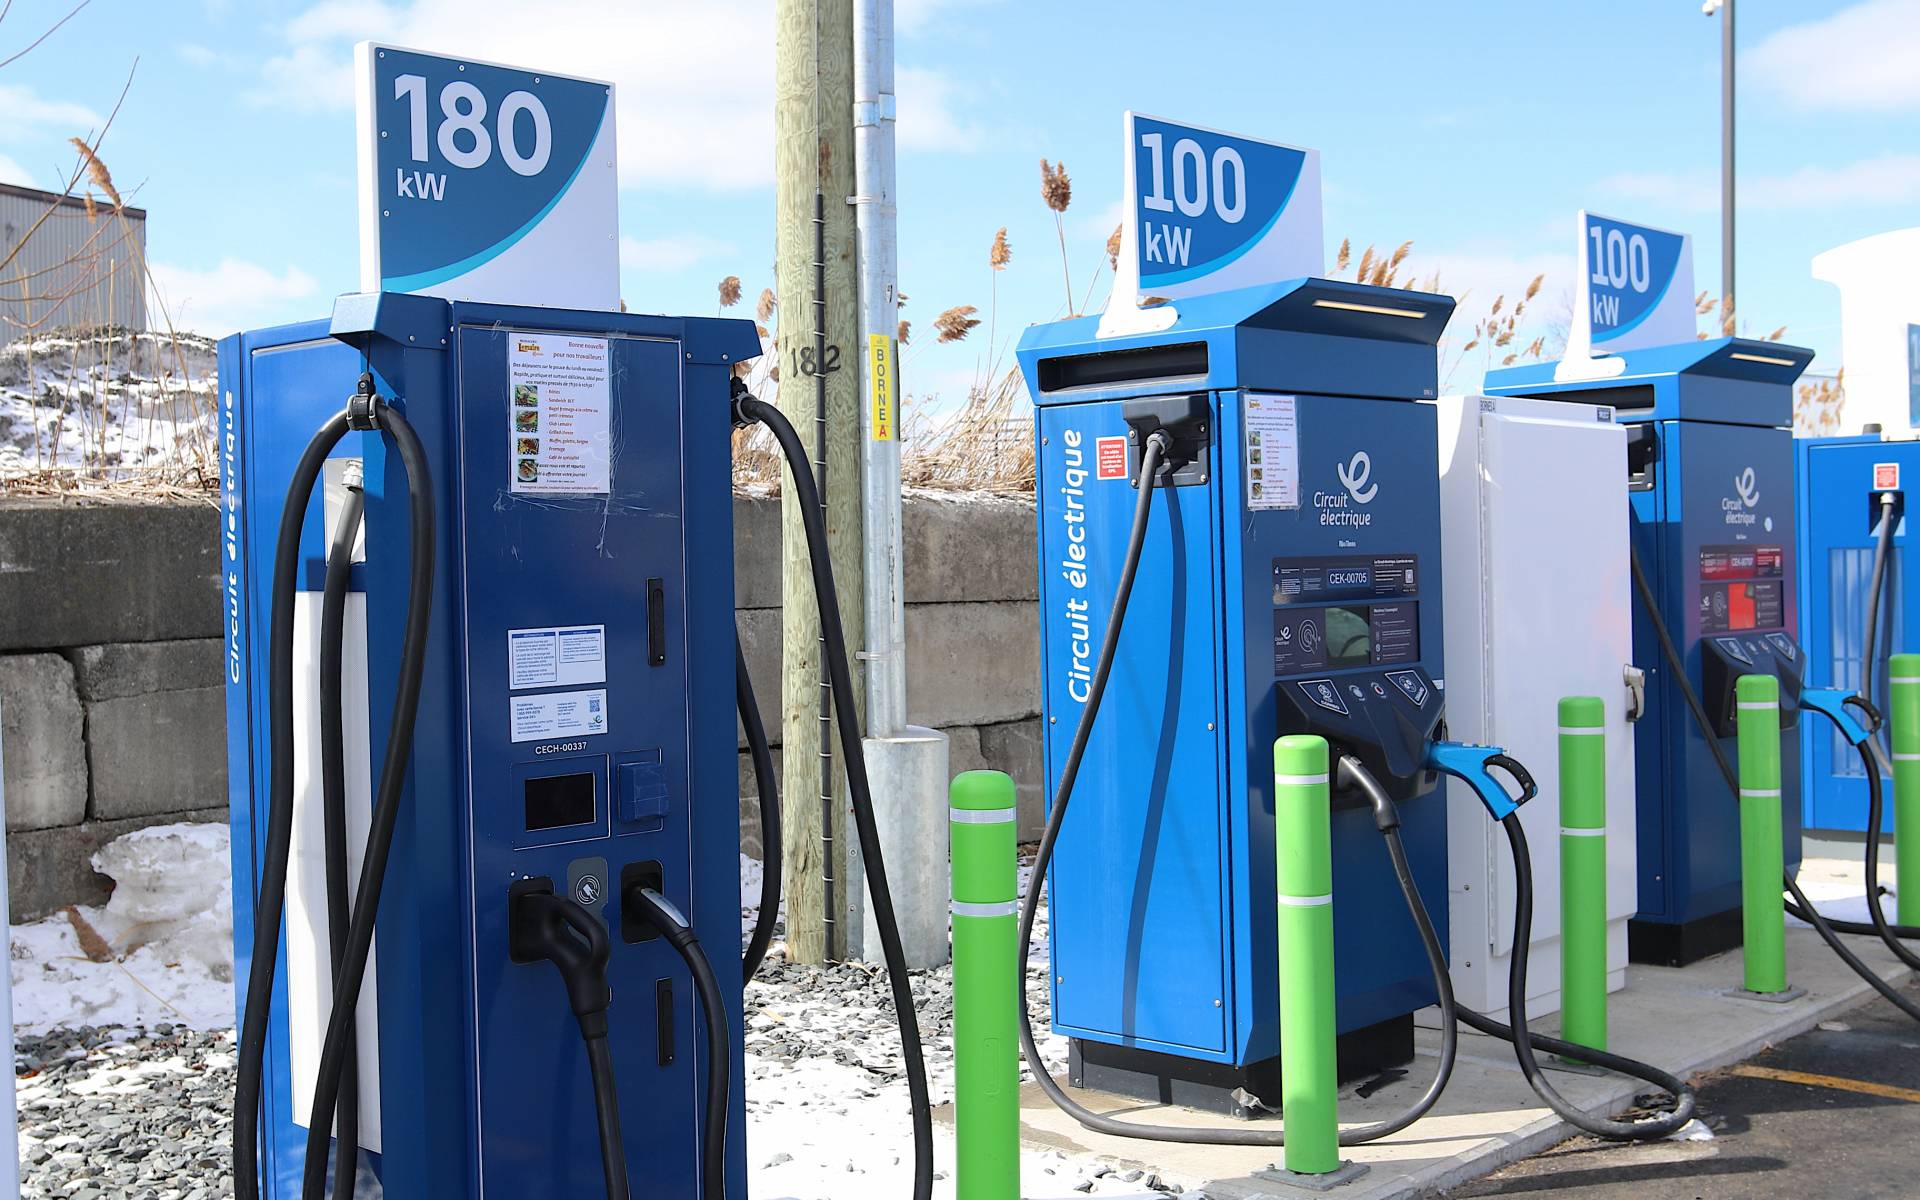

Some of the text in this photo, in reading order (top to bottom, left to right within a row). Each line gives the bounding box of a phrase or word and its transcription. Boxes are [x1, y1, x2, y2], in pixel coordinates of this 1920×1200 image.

[394, 74, 552, 176] 180
[397, 168, 447, 200] kW
[1141, 133, 1246, 223] 100
[1145, 221, 1191, 266] kW
[1590, 226, 1649, 293] 100
[1592, 293, 1619, 326] kW
[877, 349, 887, 437] BORNE A
[1314, 491, 1348, 508] Circuit
[1722, 498, 1742, 511] Circuit
[1320, 509, 1371, 529] électrique
[1726, 512, 1756, 526] électrique
[225, 390, 239, 684] Circuit électrique
[1061, 429, 1092, 703] Circuit électrique
[1330, 573, 1367, 585] CEK-00705
[535, 742, 587, 755] CECH-00337
